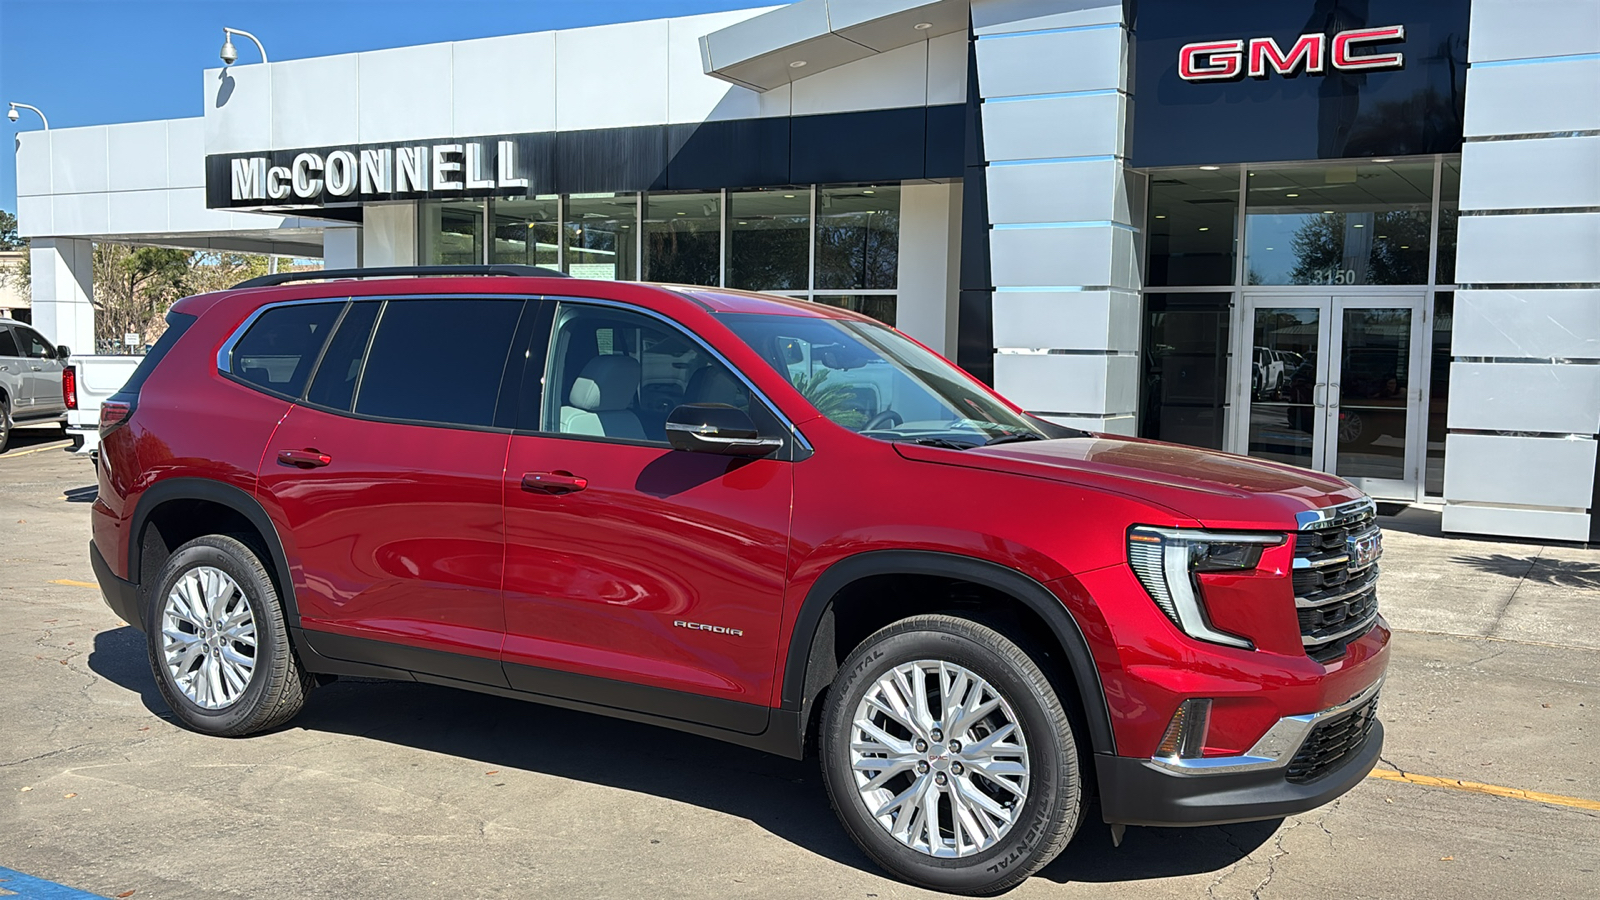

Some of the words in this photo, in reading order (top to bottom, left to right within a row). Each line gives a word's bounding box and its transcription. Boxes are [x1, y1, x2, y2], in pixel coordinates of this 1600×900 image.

[1178, 25, 1405, 81] GMC
[231, 140, 529, 201] McCONNELL
[1313, 269, 1356, 285] 3150
[673, 620, 744, 637] ACADIA
[986, 751, 1051, 874] CONTINENTAL
